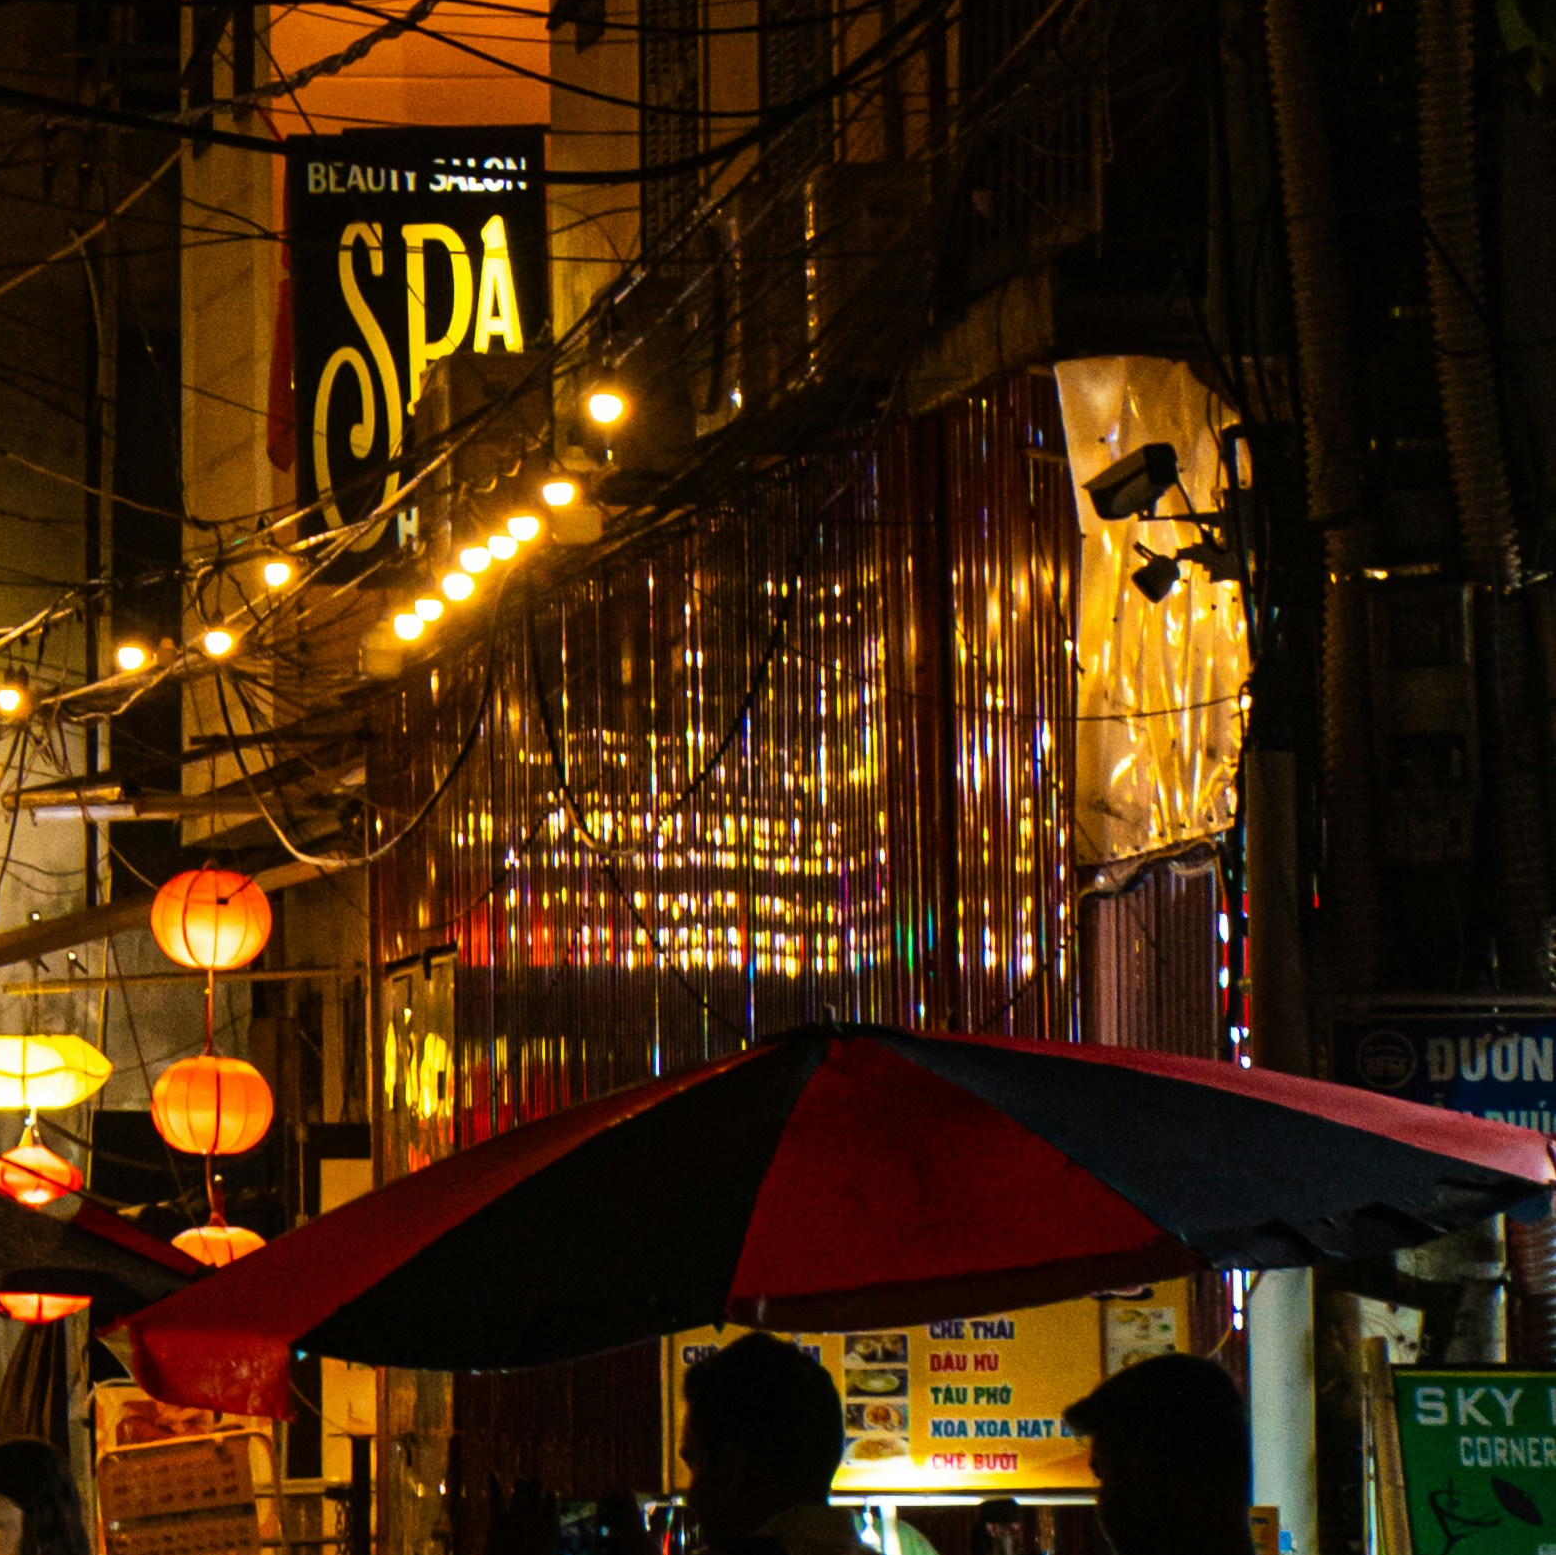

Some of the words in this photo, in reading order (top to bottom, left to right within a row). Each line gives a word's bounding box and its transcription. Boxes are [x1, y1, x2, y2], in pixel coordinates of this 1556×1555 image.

[307, 160, 417, 194] BEAUTY
[313, 214, 525, 553] SPA
[1416, 1387, 1523, 1427] SKY
